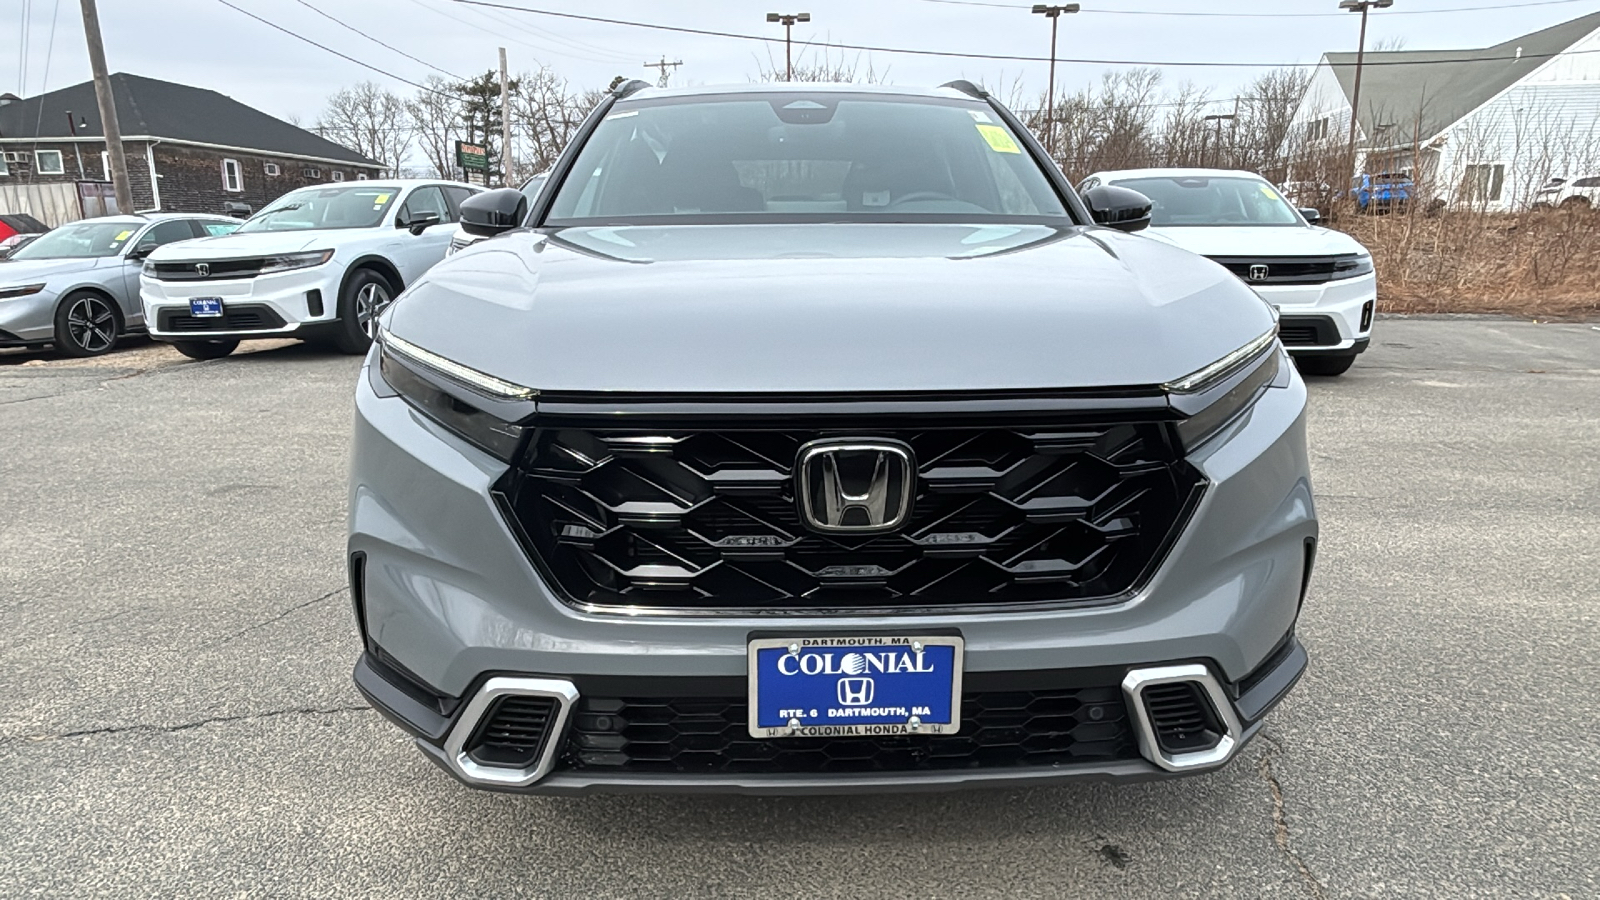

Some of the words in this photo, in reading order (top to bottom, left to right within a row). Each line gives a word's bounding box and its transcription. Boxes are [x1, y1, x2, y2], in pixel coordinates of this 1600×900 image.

[802, 638, 886, 646] DARTMOUTH,
[891, 637, 910, 645] MA
[777, 651, 934, 676] COLONIAL
[779, 708, 807, 718] RTE.
[809, 708, 818, 717] 6
[828, 706, 909, 717] DARTMOUTH,
[911, 706, 931, 716] MA
[800, 725, 861, 736] COLONIAL
[864, 724, 908, 735] HONDA
